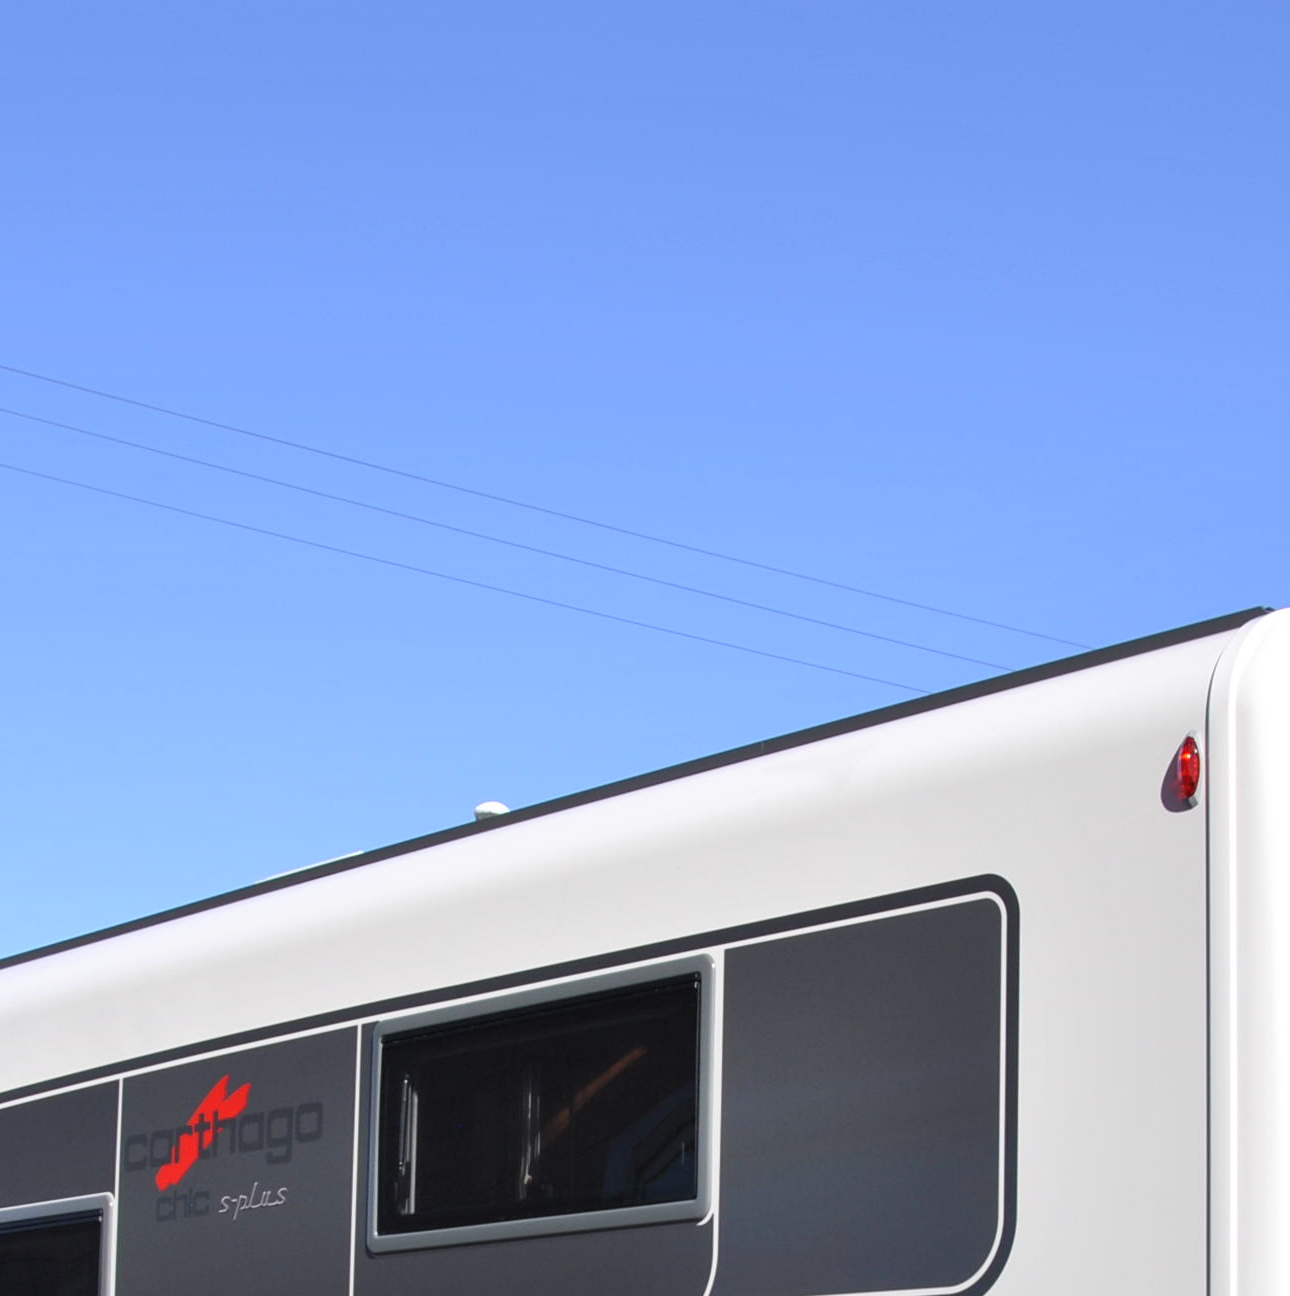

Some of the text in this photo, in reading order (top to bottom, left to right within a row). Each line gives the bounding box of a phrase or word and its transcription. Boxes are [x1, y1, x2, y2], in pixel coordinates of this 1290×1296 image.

[124, 1101, 324, 1172] carthago
[157, 1181, 288, 1222] chic s-plus
